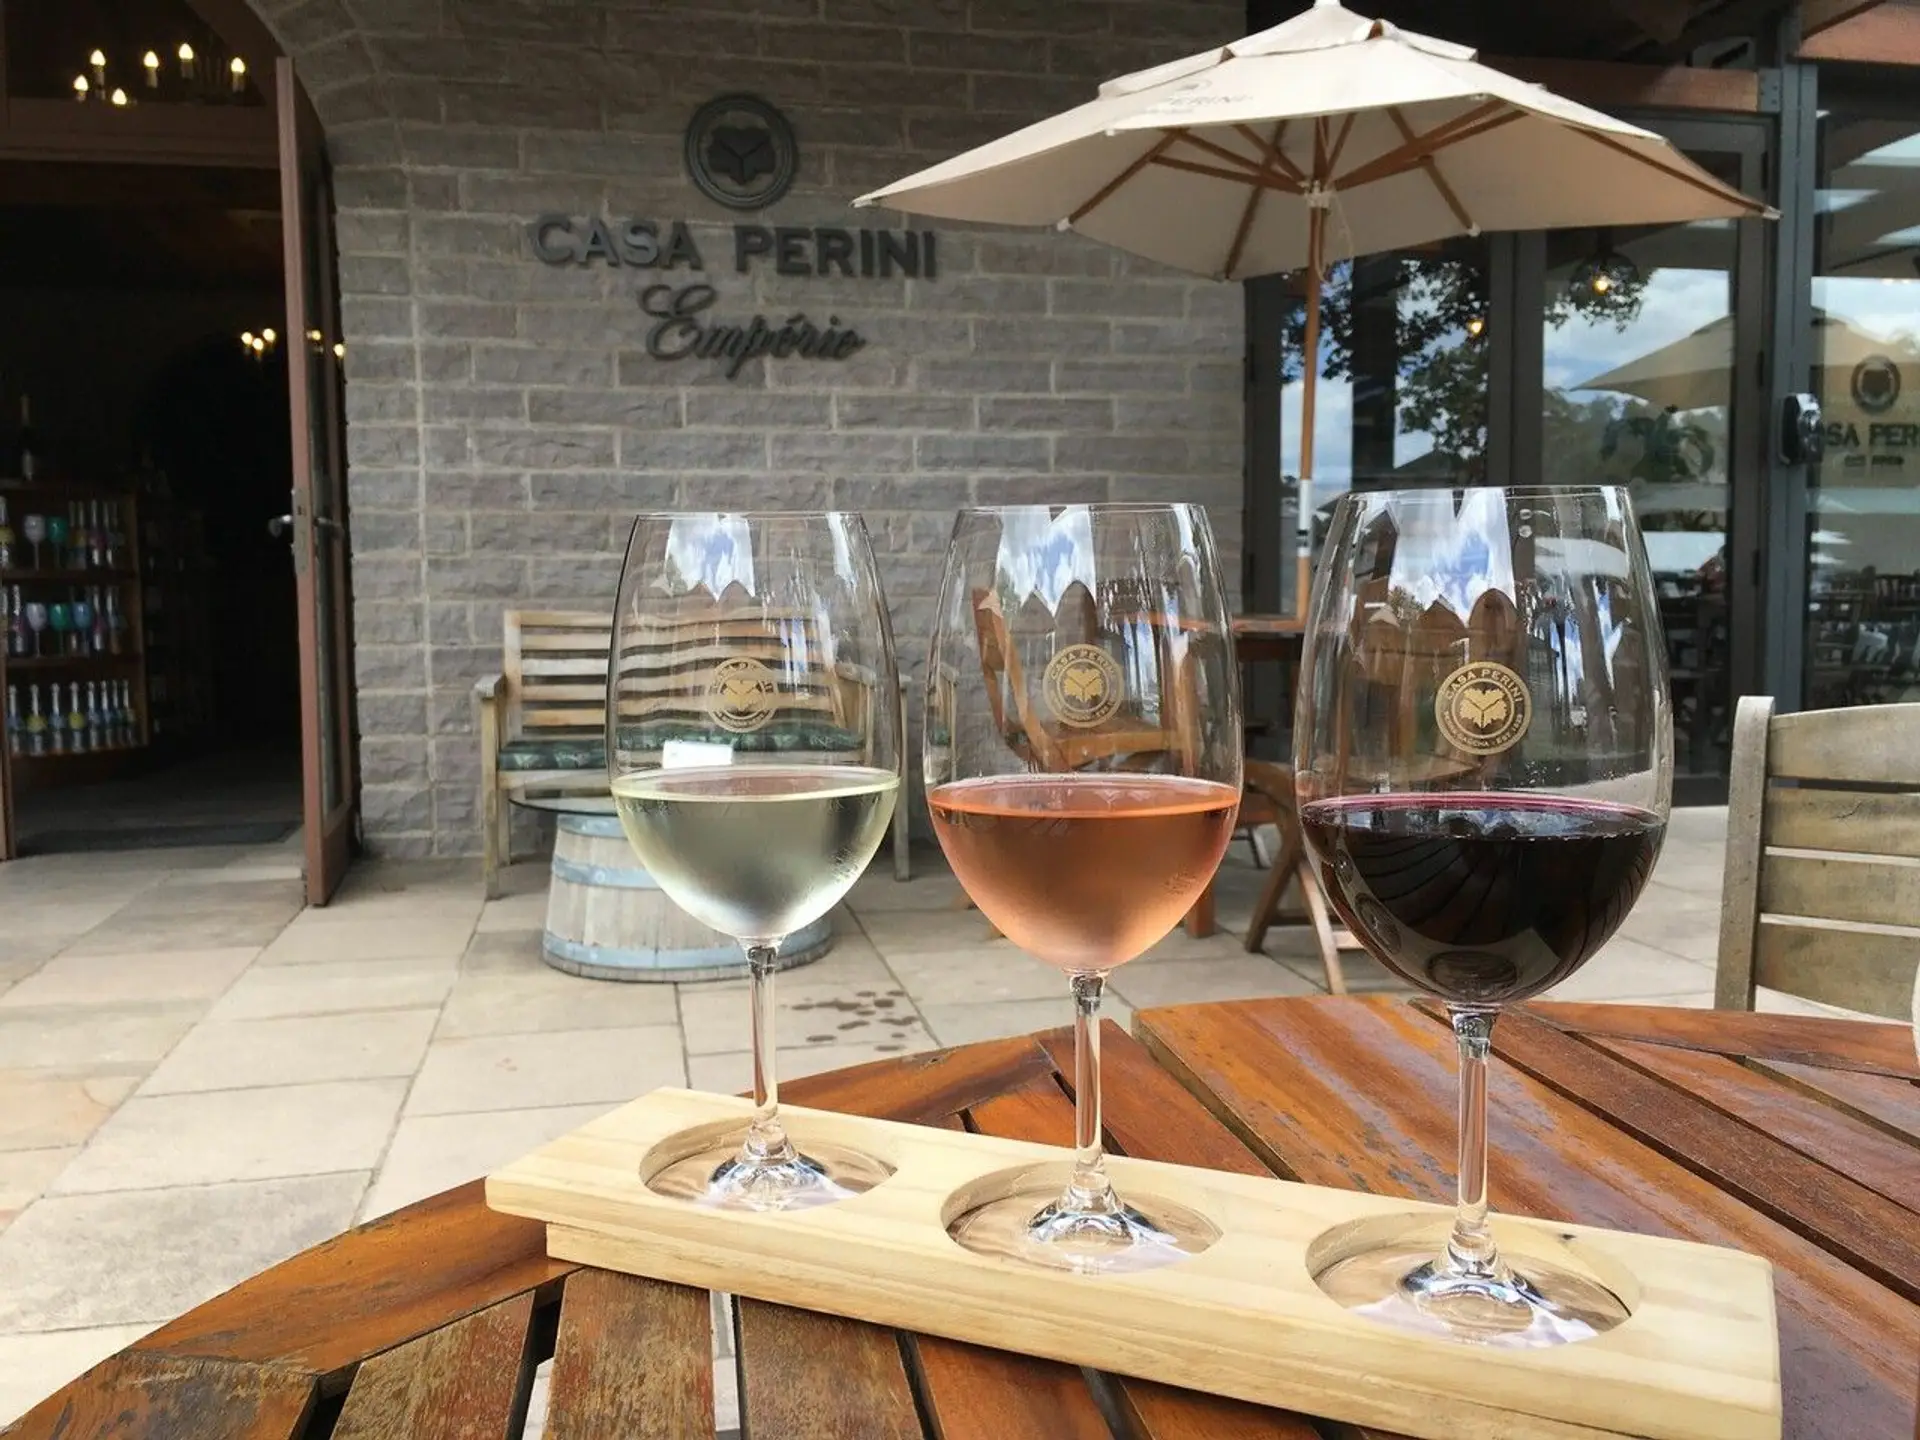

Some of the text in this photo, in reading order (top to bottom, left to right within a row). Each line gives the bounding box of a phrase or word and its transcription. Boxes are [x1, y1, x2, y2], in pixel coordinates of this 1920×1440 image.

[530, 213, 938, 280] CASA PERINI
[1446, 669, 1523, 702] CASA PERINI
